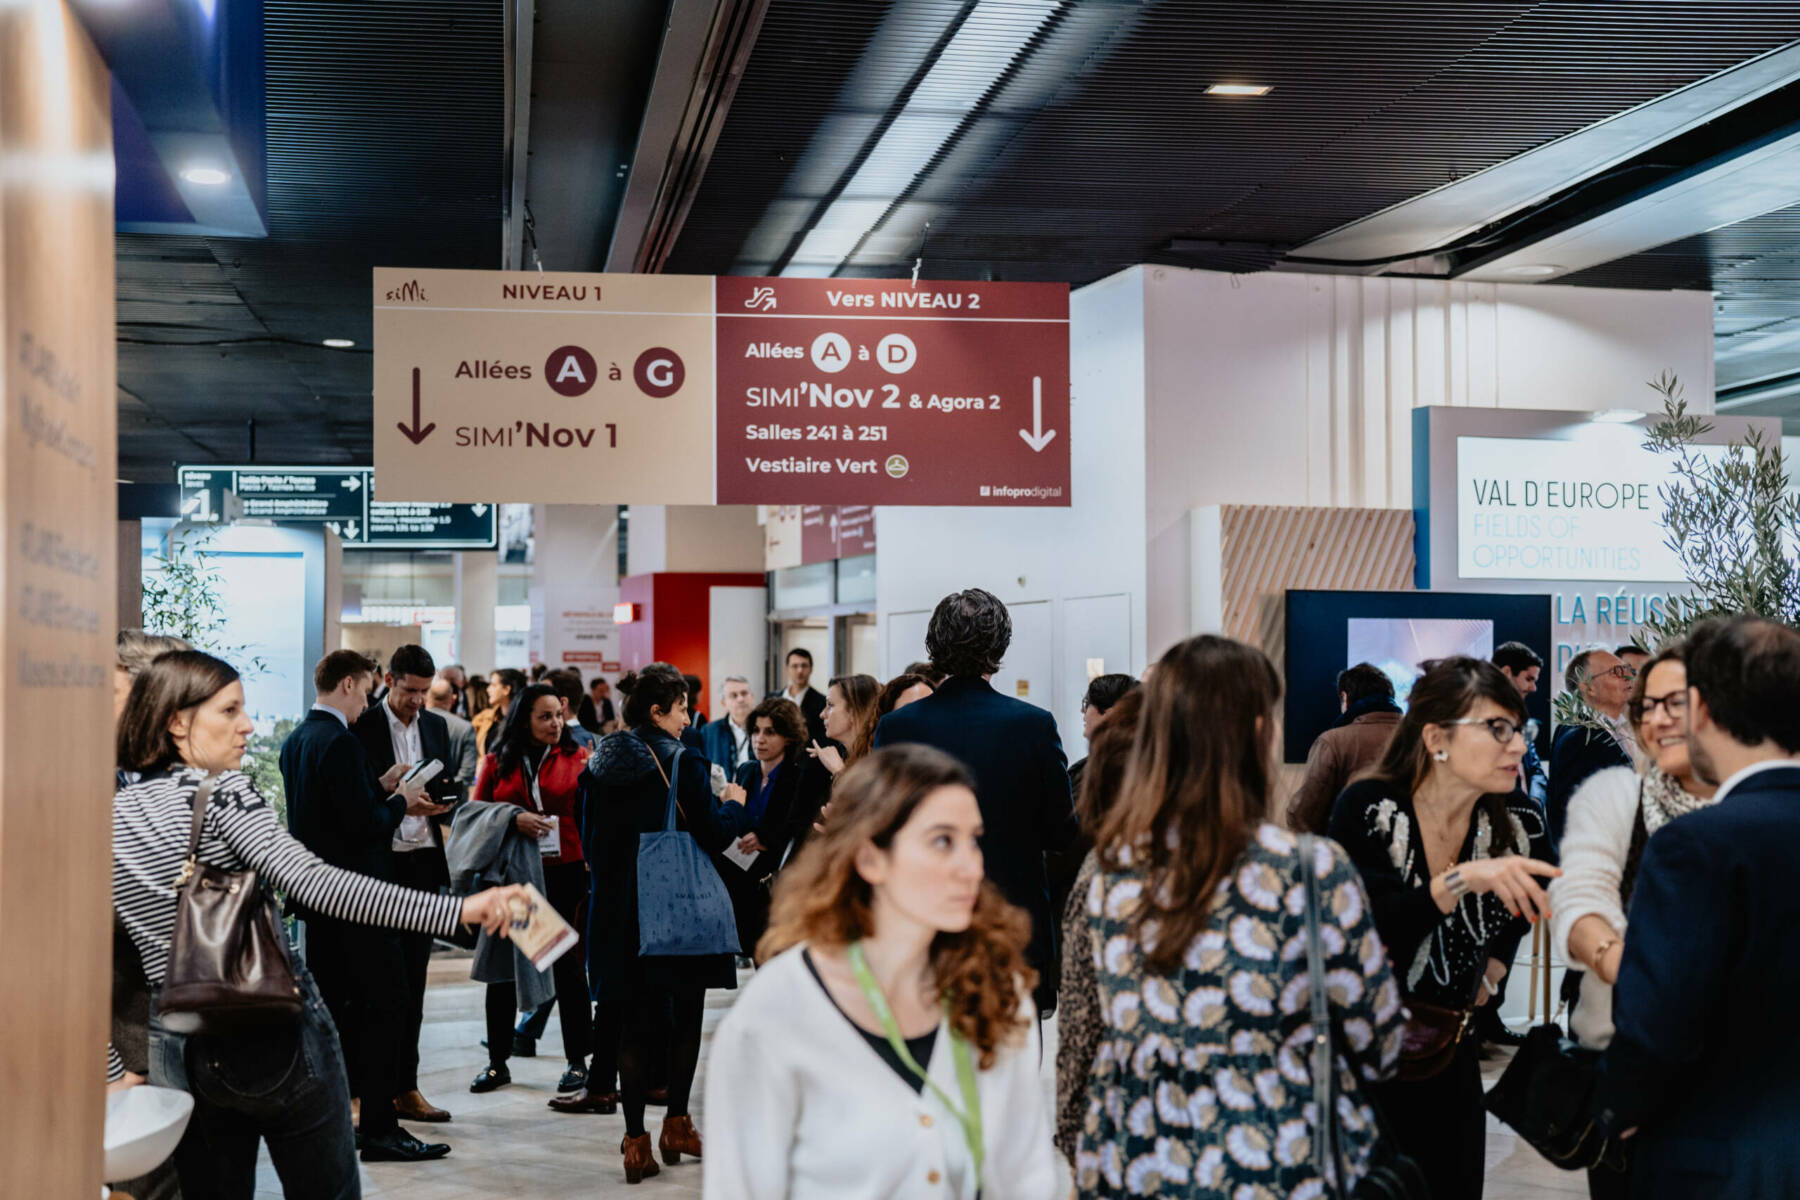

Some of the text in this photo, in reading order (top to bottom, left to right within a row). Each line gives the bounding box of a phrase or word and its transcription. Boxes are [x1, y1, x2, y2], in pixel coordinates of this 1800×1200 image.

[502, 284, 602, 301] NIVEAU 1
[826, 291, 981, 309] Vers NIVEAU 2
[745, 341, 908, 364] Allées A à D
[455, 355, 675, 388] Allées A à G
[881, 384, 901, 409] 2
[909, 395, 923, 409] &
[927, 395, 985, 413] Agora
[989, 395, 1001, 410] 2
[605, 423, 618, 448] 1
[745, 424, 888, 442] Salles 241 à 251
[745, 456, 878, 474] Vestiaire Vert
[992, 485, 1063, 499] infoprodigital
[1473, 479, 1649, 510] VAL D'EUROPE
[1473, 513, 1580, 539] FIELDS OF
[1472, 544, 1641, 571] OPPORTUNITIES
[1556, 594, 1587, 625] LA
